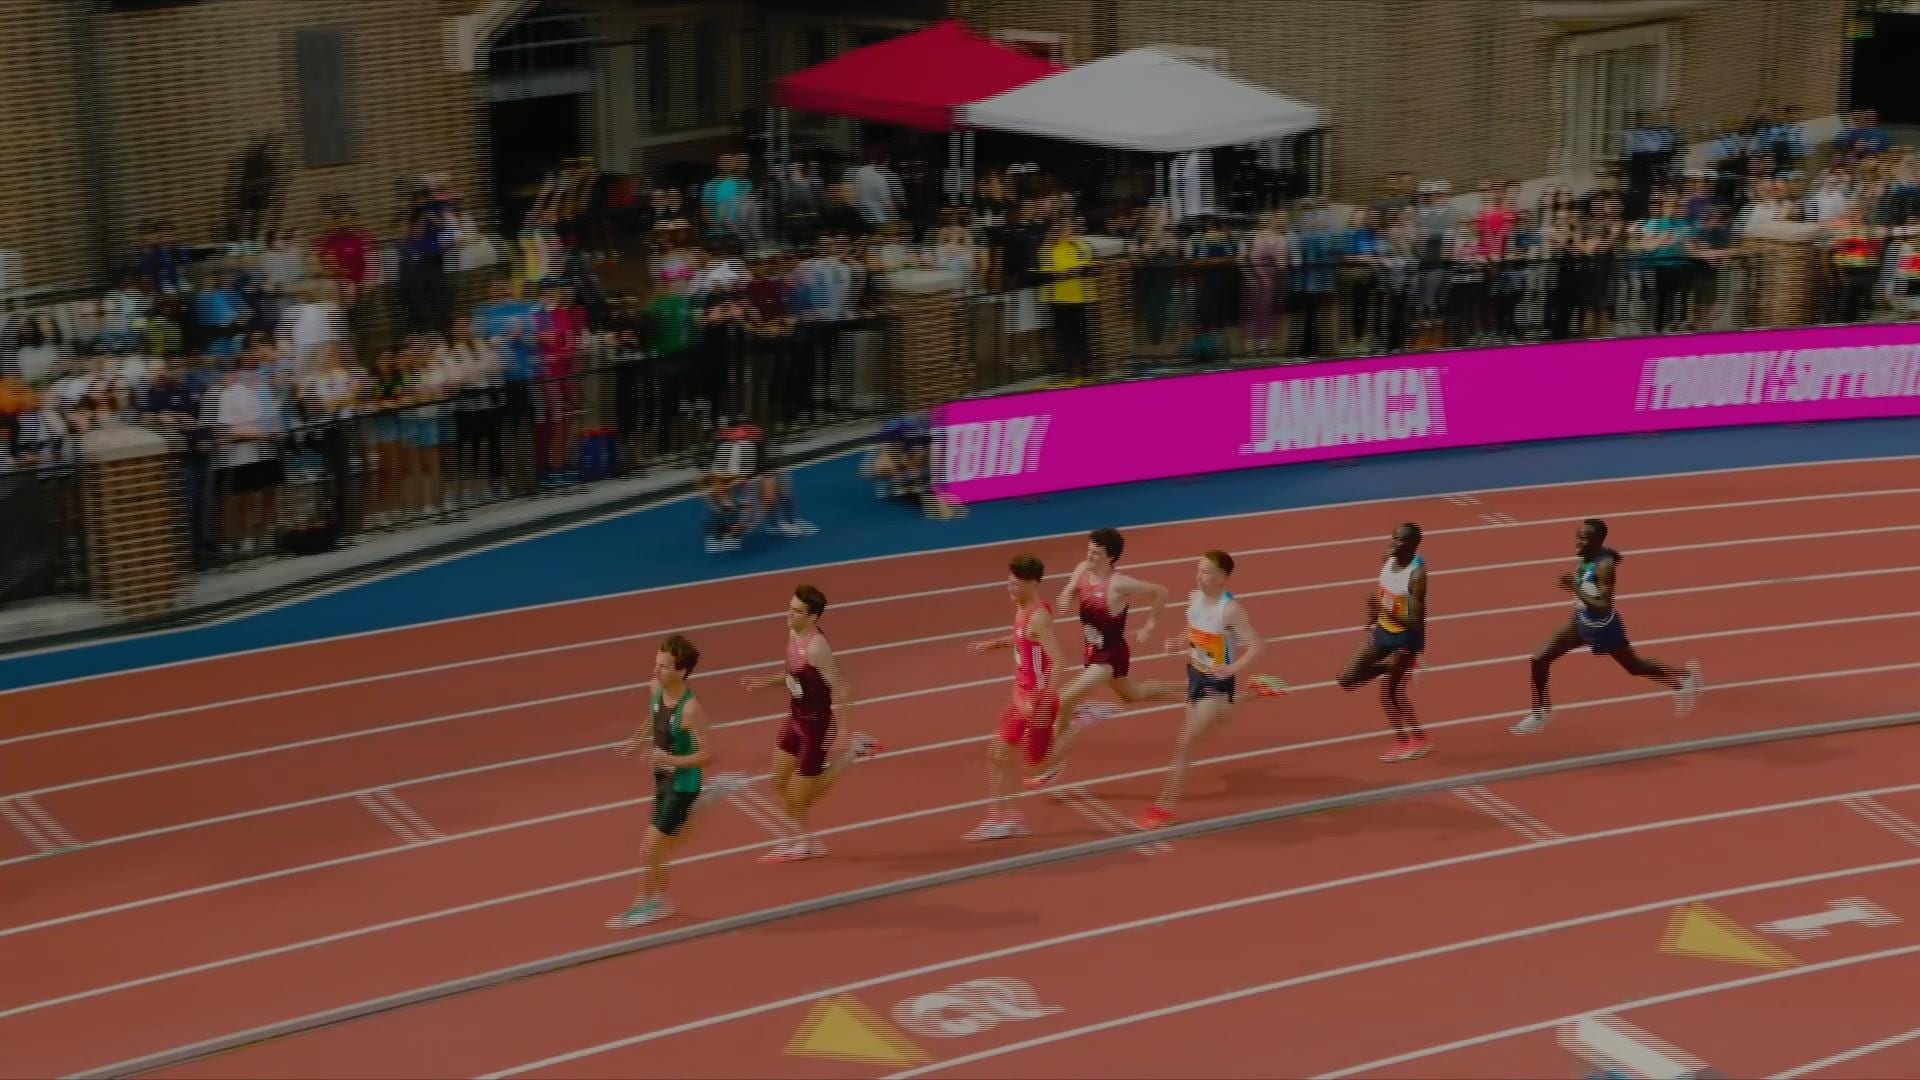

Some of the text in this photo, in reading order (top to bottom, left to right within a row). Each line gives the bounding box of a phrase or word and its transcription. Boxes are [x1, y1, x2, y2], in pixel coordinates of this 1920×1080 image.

[1238, 366, 1448, 456] JAMAICA
[1635, 350, 1791, 412] PROUDLY
[1752, 895, 1904, 940] 1
[890, 976, 1067, 1038] 2
